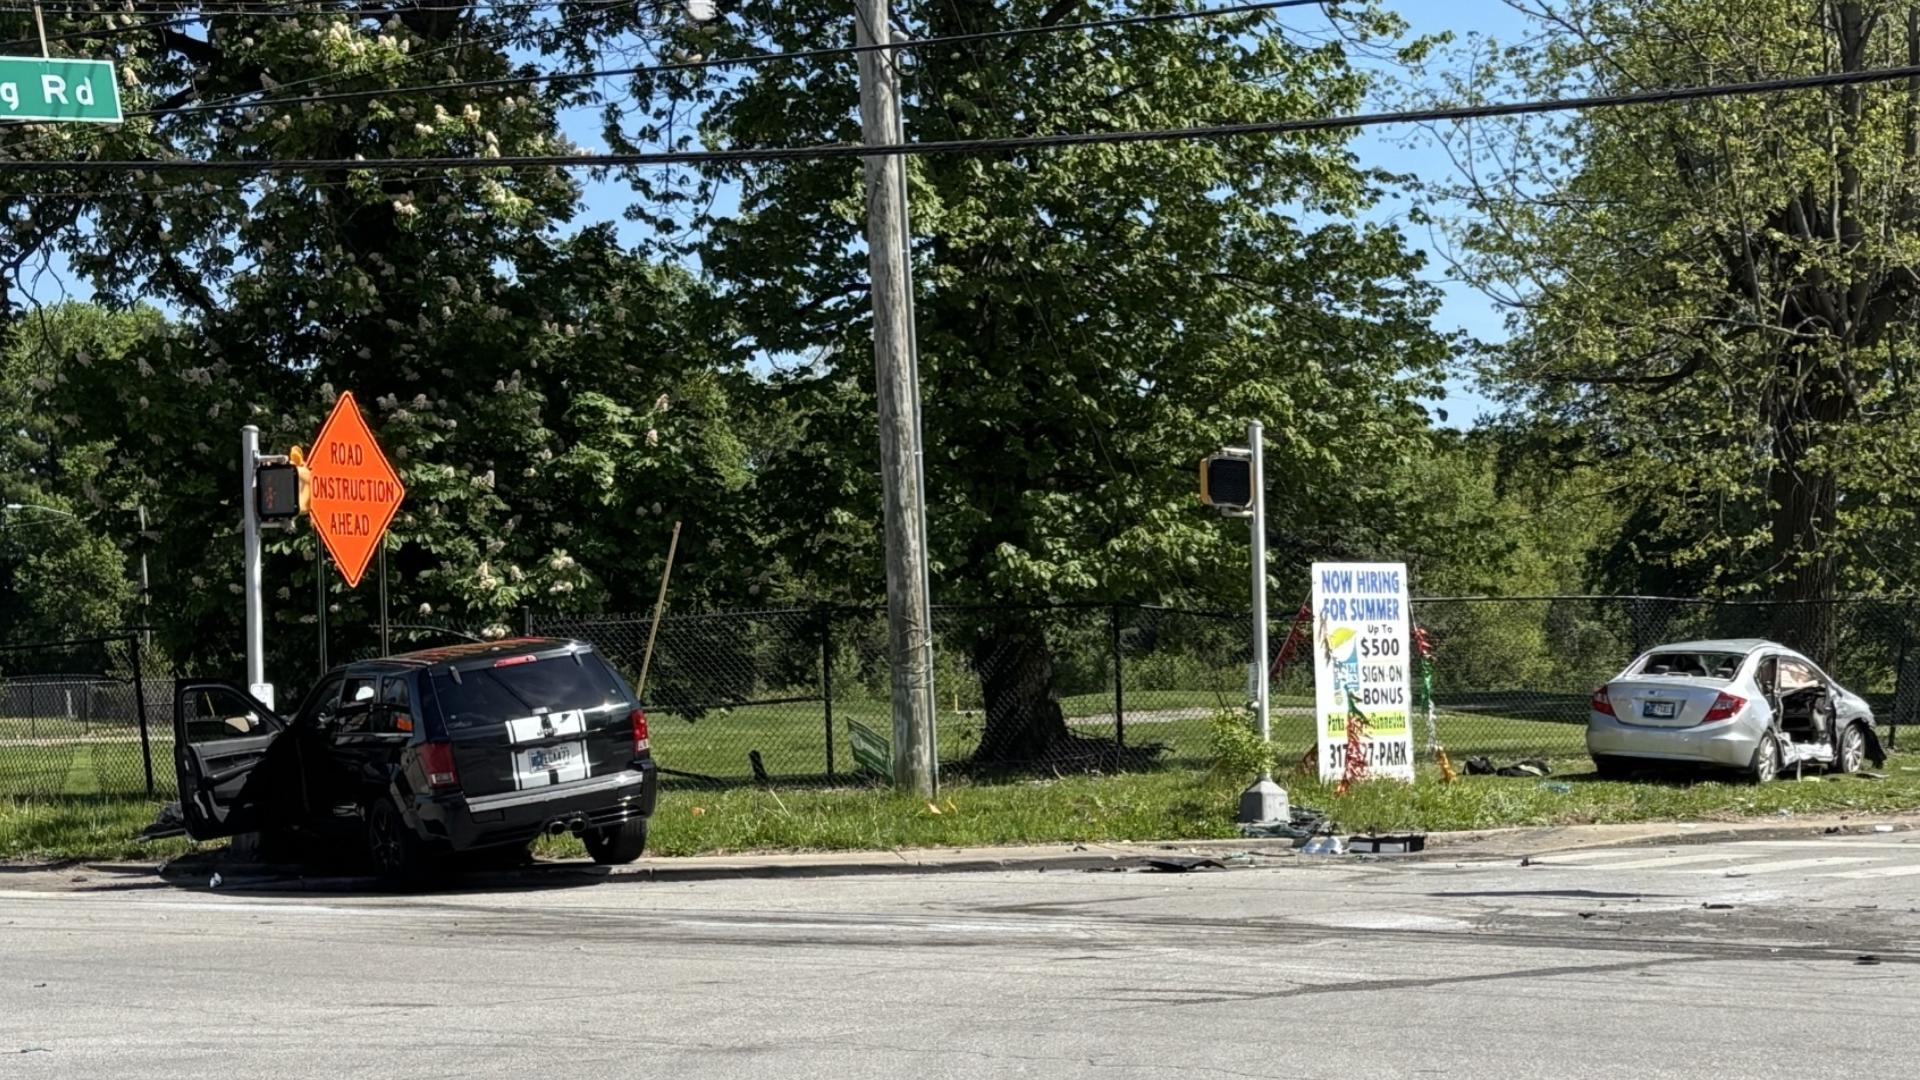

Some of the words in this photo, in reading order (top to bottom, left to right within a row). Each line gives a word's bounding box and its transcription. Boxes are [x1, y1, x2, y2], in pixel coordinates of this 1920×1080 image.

[41, 74, 95, 106] Rd
[331, 442, 363, 466] ROAD
[312, 476, 394, 502] ONSTRUCTION
[330, 513, 370, 536] AHEAD
[1321, 570, 1353, 594] NOW
[1356, 570, 1400, 594] HIRING
[1323, 598, 1348, 621] FOR
[1350, 598, 1400, 621] SUMMER
[1367, 624, 1379, 635] Up
[1381, 624, 1393, 634] To
[1360, 637, 1400, 658] $500
[1362, 665, 1403, 683] SIGN-ON
[1363, 687, 1404, 705] BONUS
